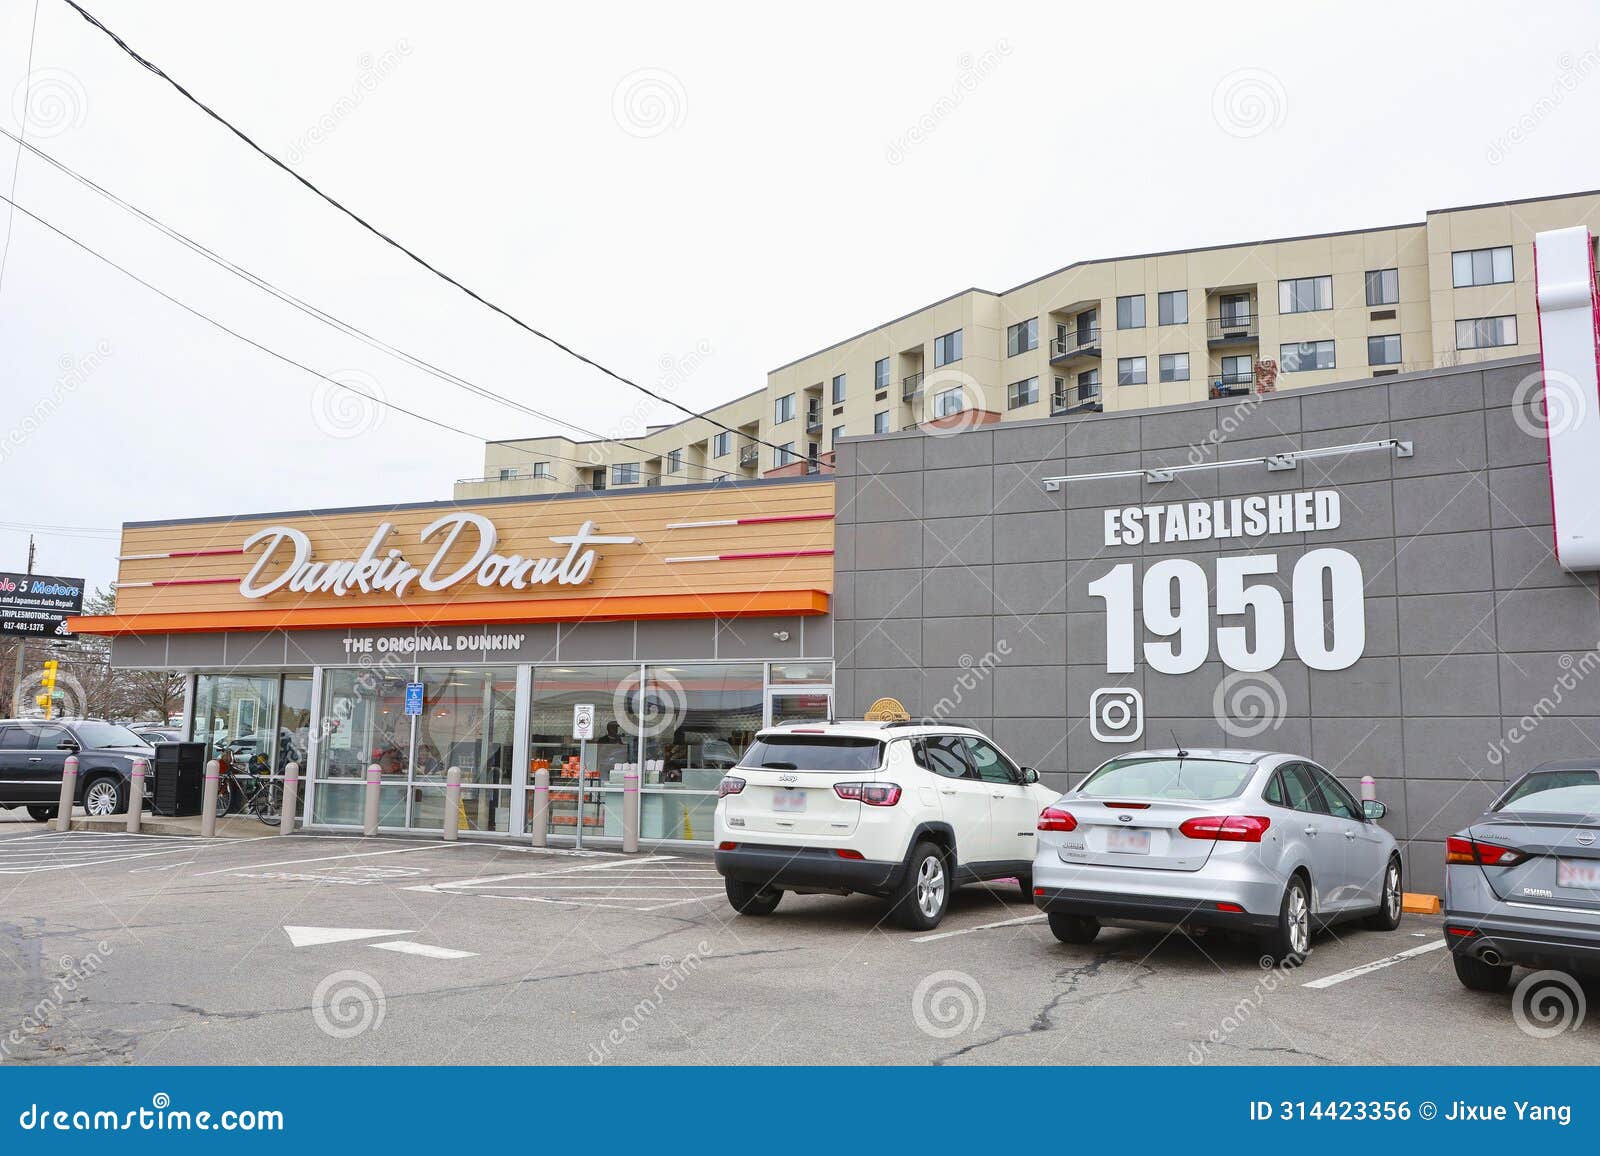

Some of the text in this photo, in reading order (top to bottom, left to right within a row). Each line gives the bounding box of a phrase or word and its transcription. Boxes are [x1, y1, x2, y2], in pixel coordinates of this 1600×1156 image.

[1104, 490, 1341, 546] ESTABLISHED
[239, 512, 638, 599] Dunkin Donuts
[19, 580, 28, 592] 5
[31, 581, 79, 596] Motors
[55, 600, 74, 608] Repair
[1088, 548, 1365, 674] 1950
[343, 634, 525, 652] THE ORIGINAL DUNKIN'
